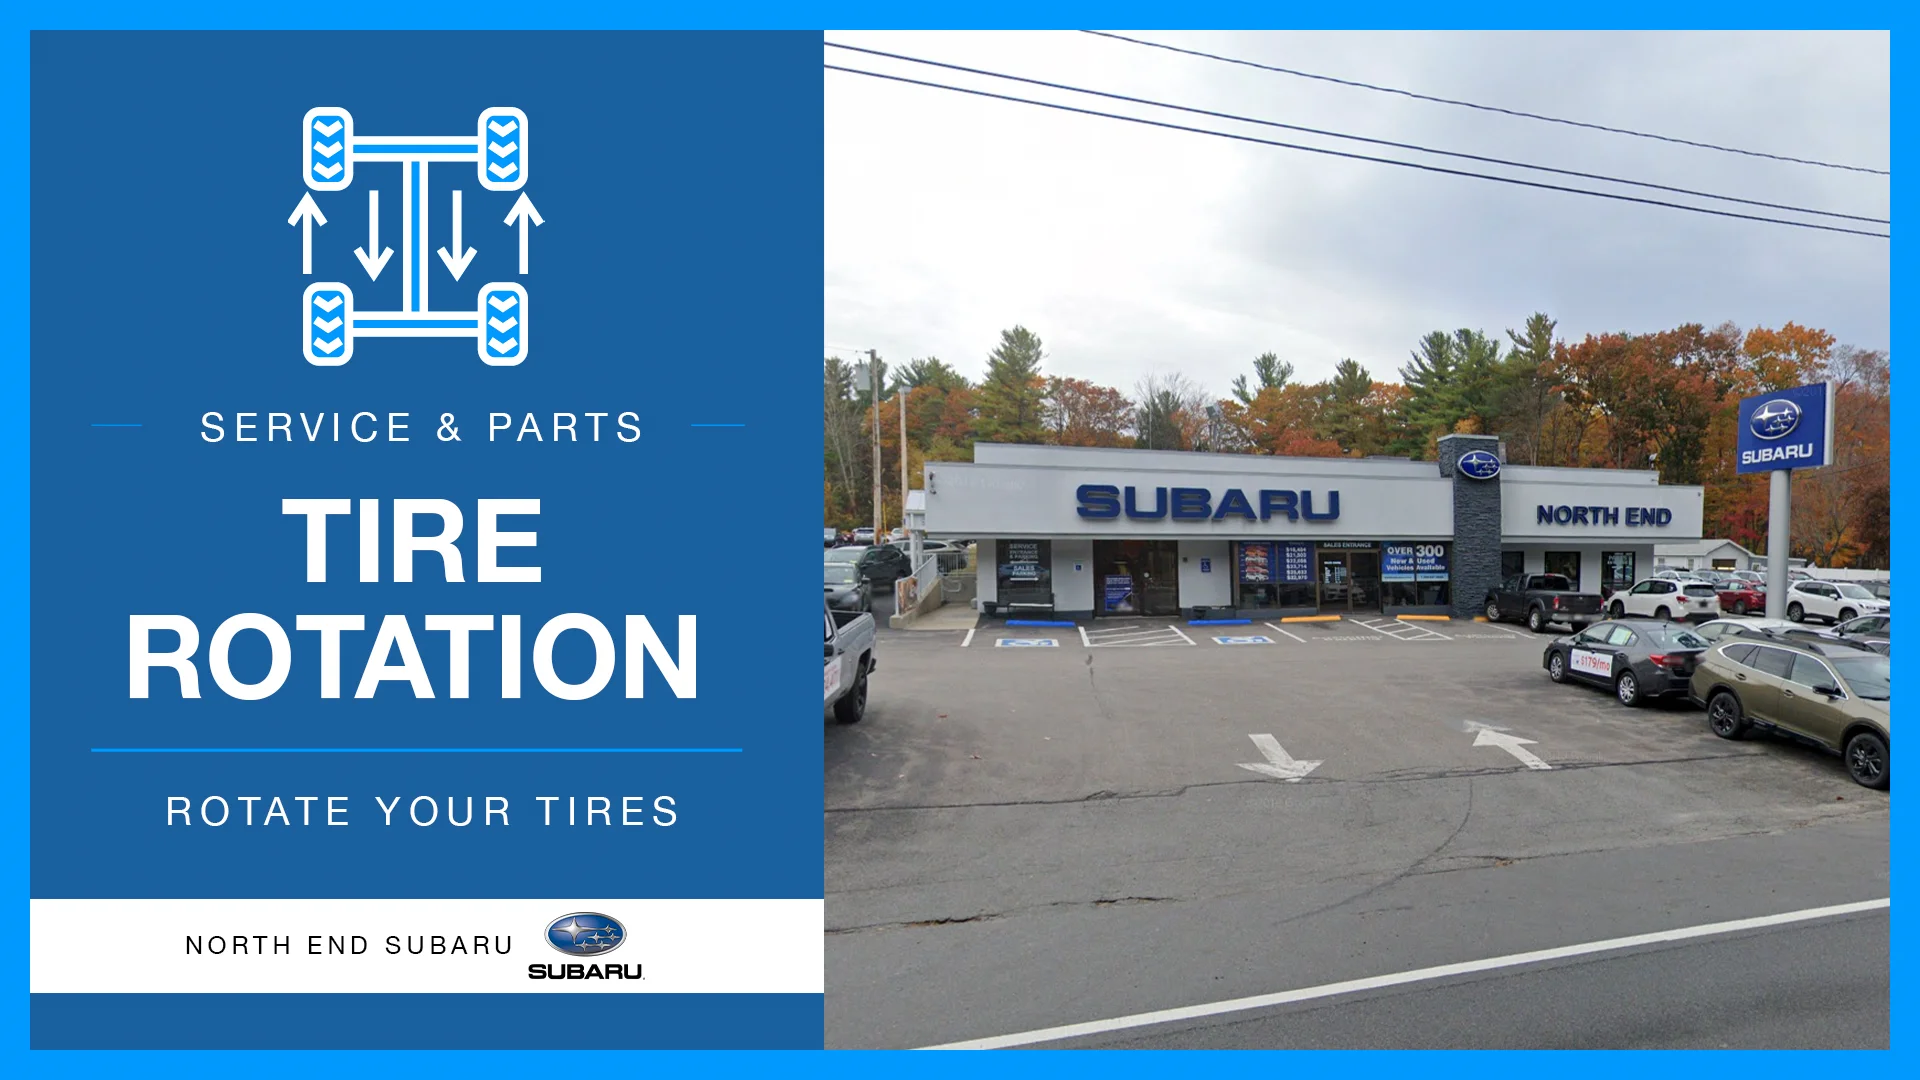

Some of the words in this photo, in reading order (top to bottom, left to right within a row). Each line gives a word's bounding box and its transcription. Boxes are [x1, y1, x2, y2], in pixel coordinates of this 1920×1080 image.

[1741, 442, 1814, 465] SUBARU
[1076, 484, 1341, 522] SUBARU
[1536, 504, 1619, 526] NORTH
[1625, 507, 1673, 527] END
[1387, 546, 1413, 555] OVER
[1416, 544, 1444, 558] 300
[1390, 557, 1407, 565] New
[1416, 557, 1435, 565] Used
[1580, 655, 1611, 672] $179/mo
